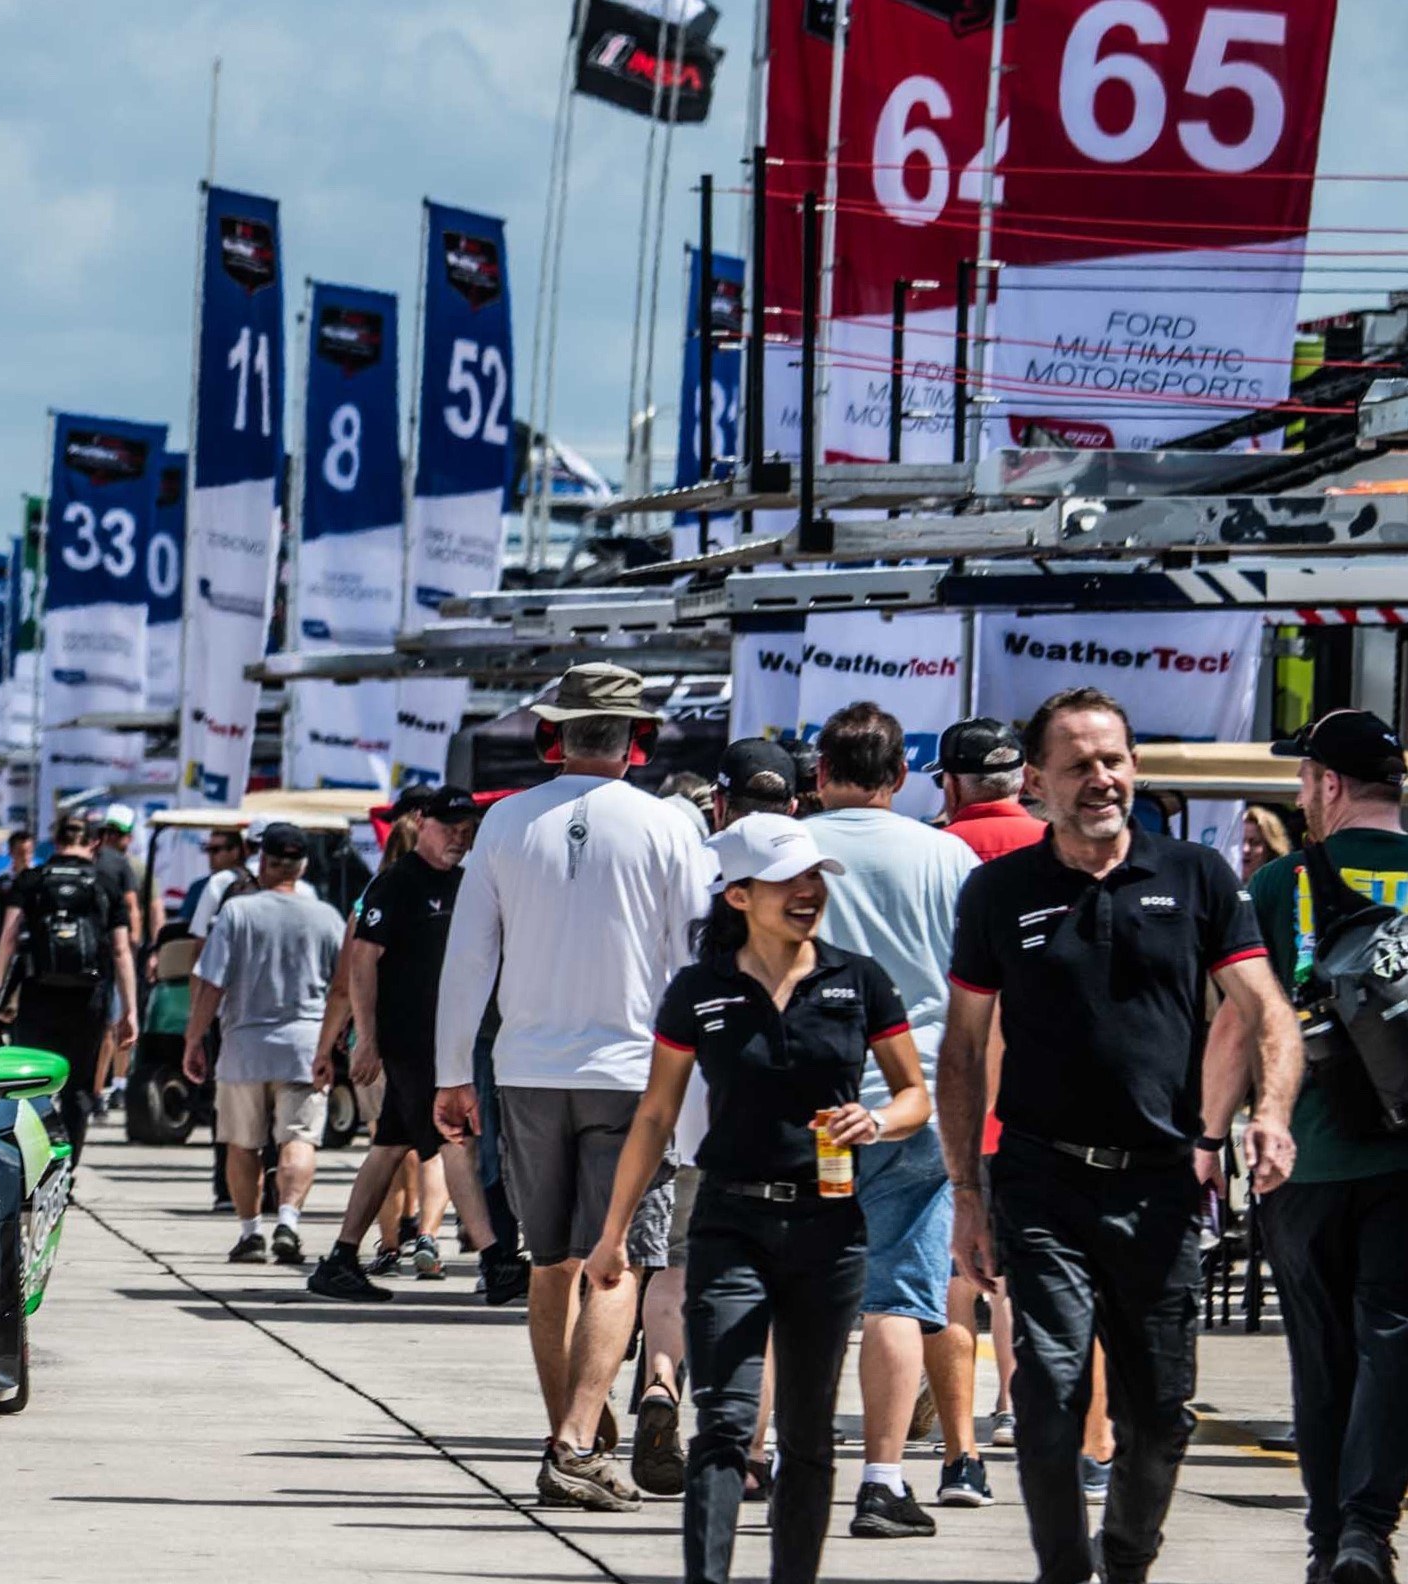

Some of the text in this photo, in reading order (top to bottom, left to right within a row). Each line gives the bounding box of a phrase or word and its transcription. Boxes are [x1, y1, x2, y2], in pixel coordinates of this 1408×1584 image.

[1059, 0, 1285, 173] 65
[1052, 334, 1245, 373] MULTIMATIC
[1106, 310, 1196, 339] FORD
[227, 326, 271, 437] 11
[443, 338, 509, 446] 52
[1024, 359, 1263, 402] MOTORSPORTS
[322, 403, 361, 491] 8
[62, 501, 135, 578] 33
